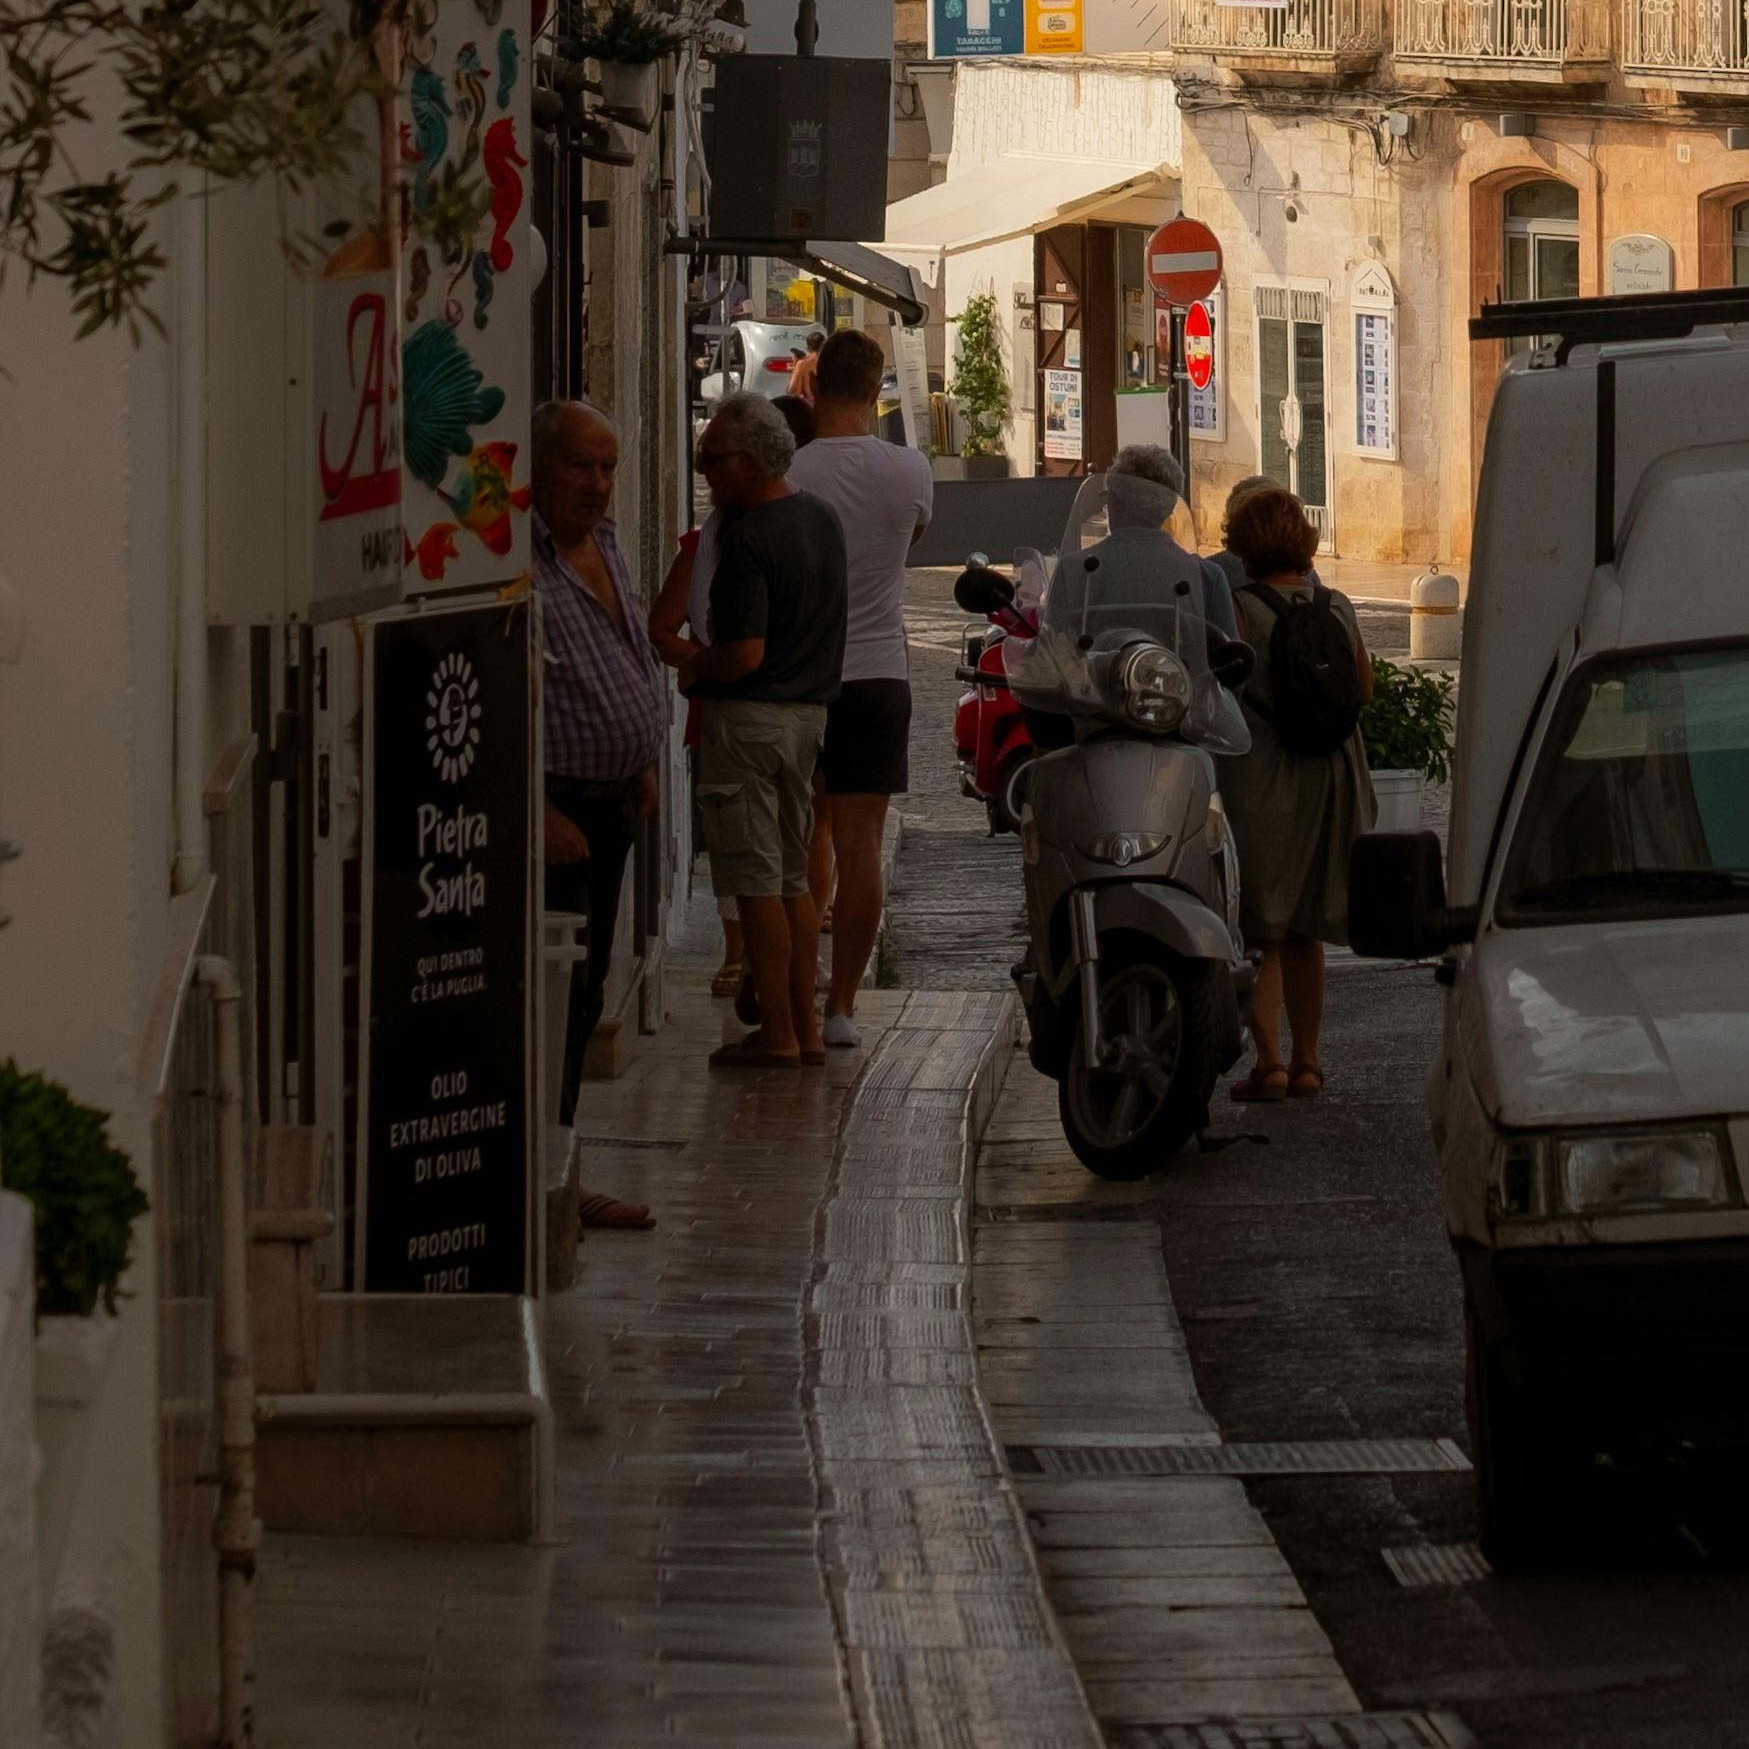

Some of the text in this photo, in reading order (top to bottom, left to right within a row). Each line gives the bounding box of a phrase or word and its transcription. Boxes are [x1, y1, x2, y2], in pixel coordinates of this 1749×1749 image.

[1049, 372, 1078, 382] TOUR DI
[1049, 382, 1078, 392] OSTUNI
[416, 803, 489, 859] Pietra
[416, 860, 486, 919] Santa
[416, 946, 484, 978] QUI DENTRO
[431, 980, 445, 1001] LA
[430, 1069, 468, 1100] OLIO
[389, 1102, 508, 1150] EXTRAVERGINE
[414, 1145, 482, 1186] DI OLIVA
[407, 1221, 487, 1262] PRODOTTI
[422, 1265, 470, 1293] TIPICI
